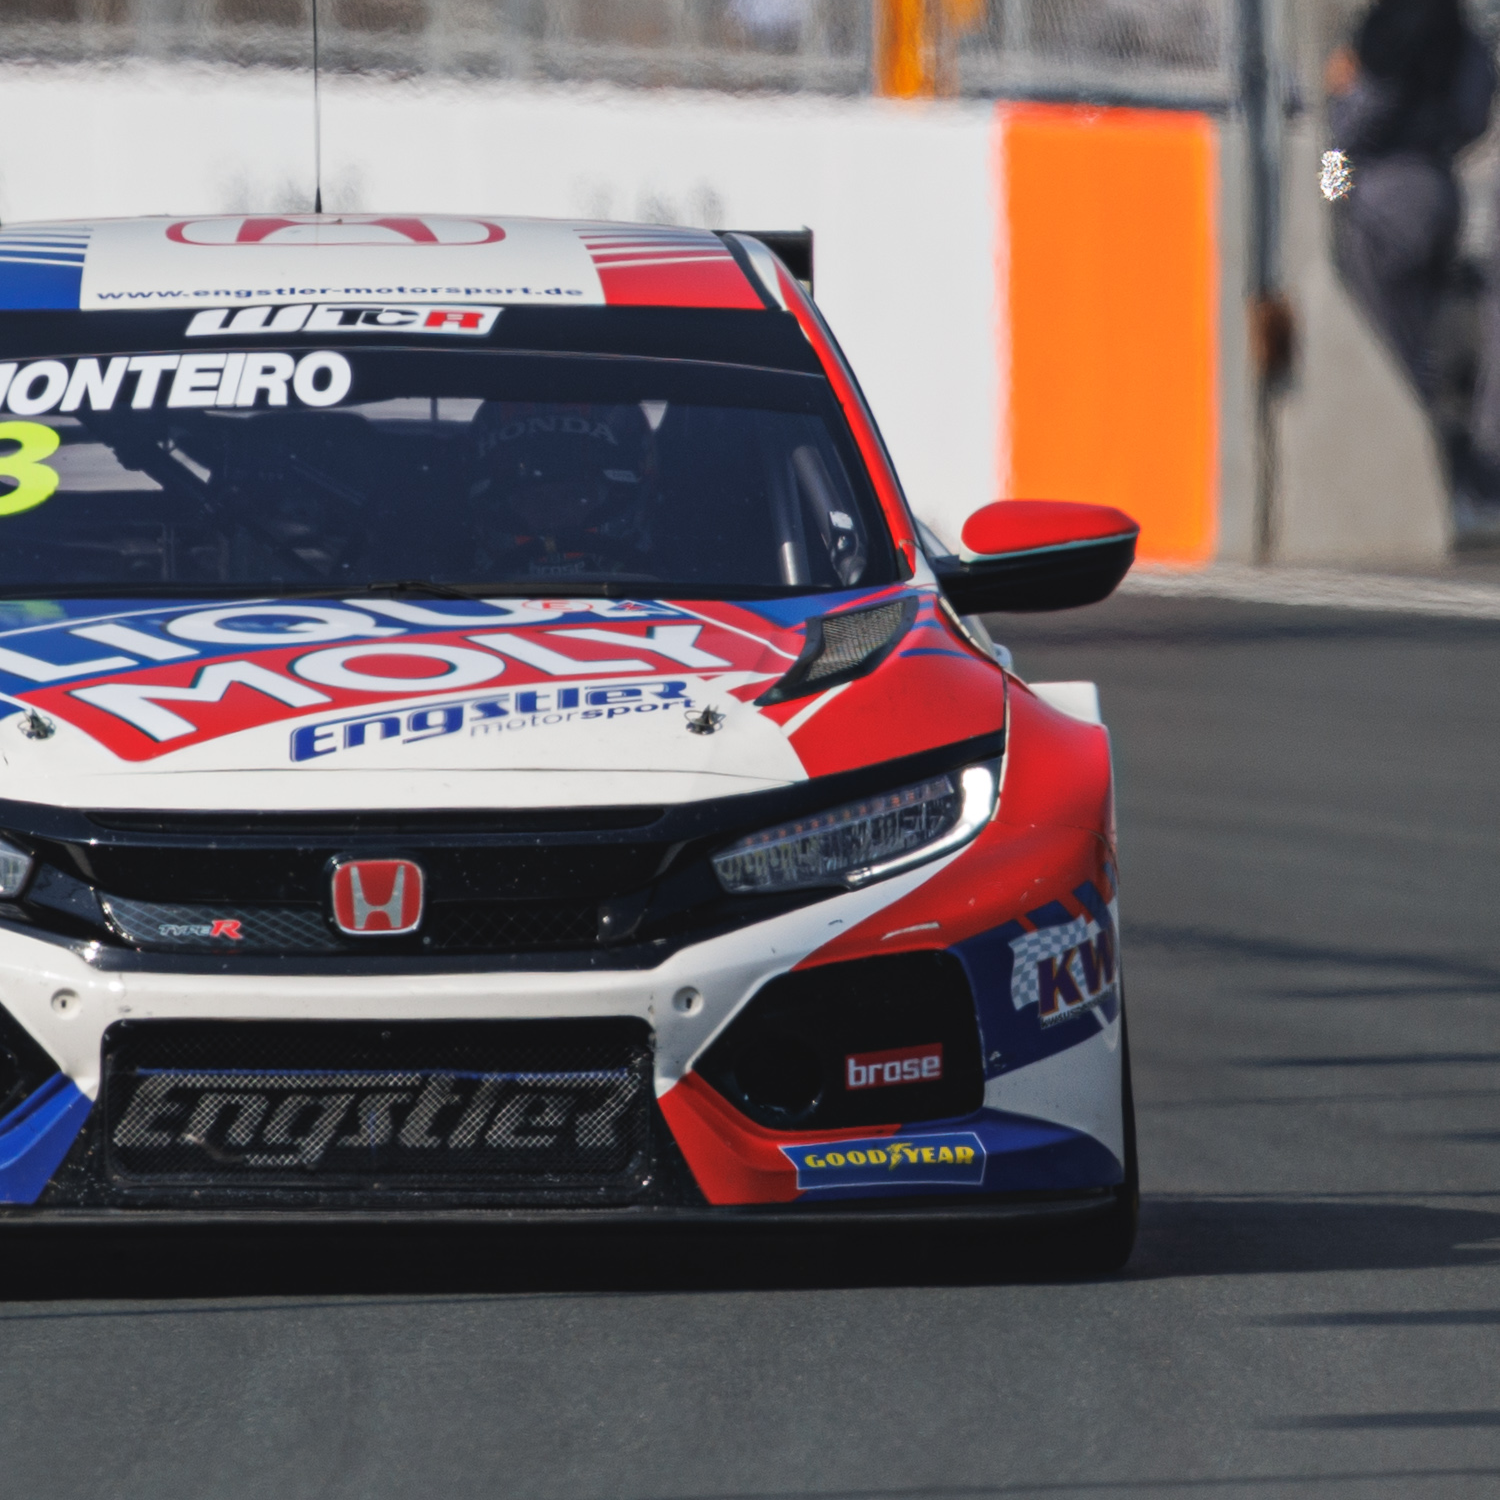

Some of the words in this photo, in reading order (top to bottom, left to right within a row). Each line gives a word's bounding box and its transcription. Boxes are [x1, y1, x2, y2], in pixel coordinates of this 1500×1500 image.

[96, 283, 584, 300] www.engstler-motorsport.de
[65, 624, 734, 743] MOLY
[470, 698, 696, 738] motorsport
[209, 919, 244, 940] R
[1037, 930, 1118, 1018] KW
[848, 1055, 941, 1088] brose
